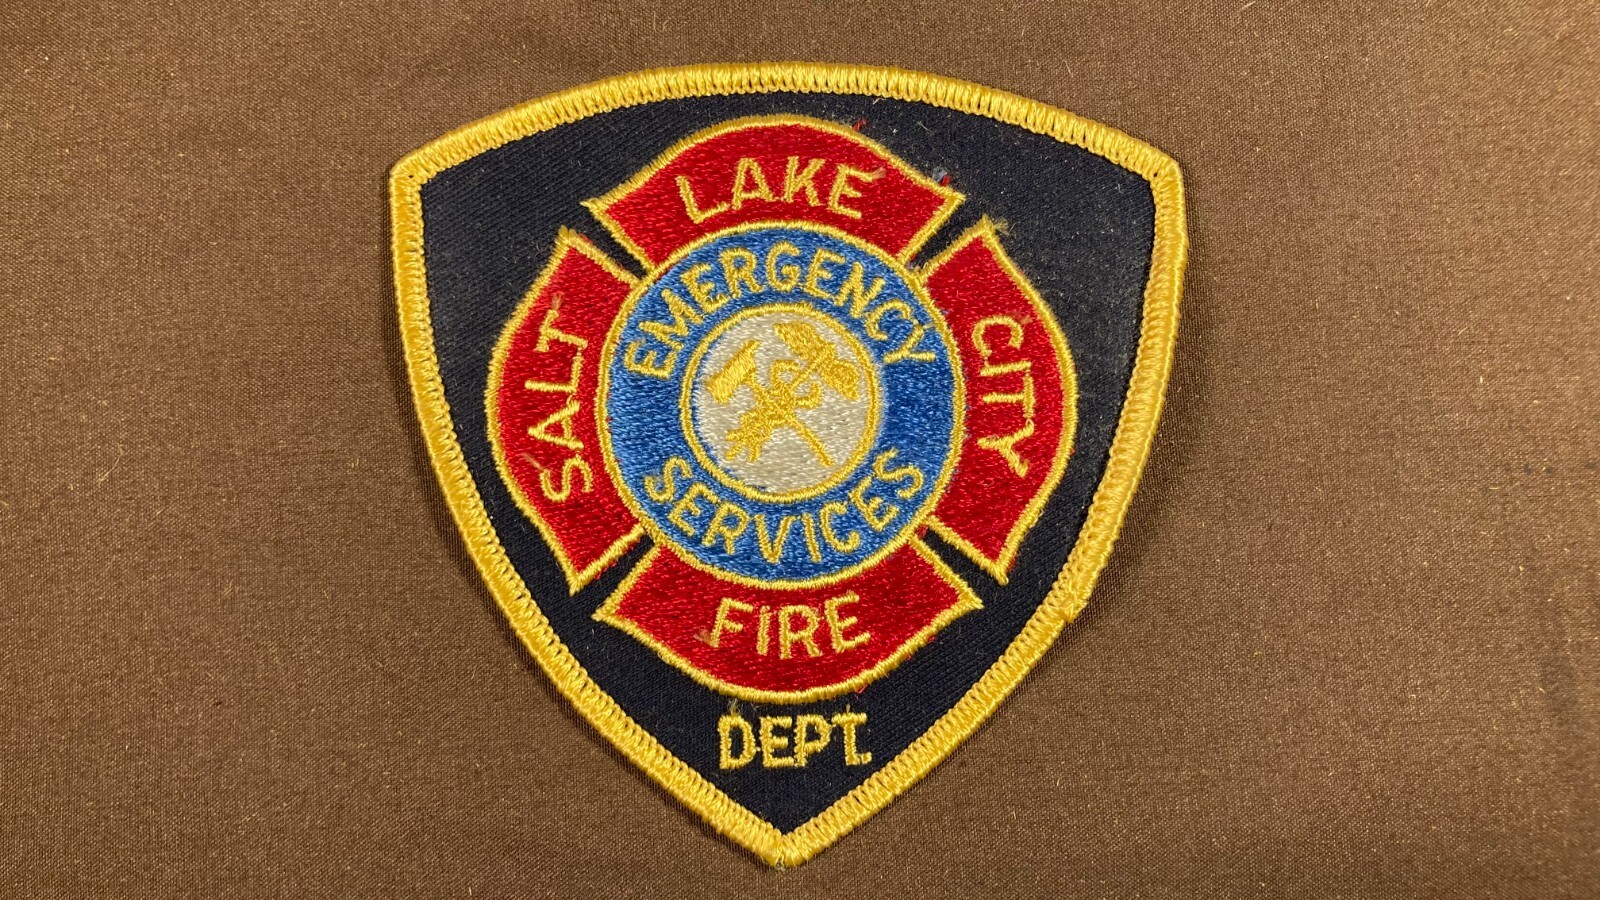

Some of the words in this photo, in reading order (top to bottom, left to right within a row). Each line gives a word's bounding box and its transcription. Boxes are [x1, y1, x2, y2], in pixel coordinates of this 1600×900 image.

[524, 308, 593, 503] SALT
[677, 156, 882, 224] LAKE
[970, 314, 1035, 478] CITY
[622, 241, 937, 380] EMERGENCY
[642, 447, 927, 564] SERVICES
[708, 595, 871, 660] FIRE
[718, 711, 873, 770] DEPT.
